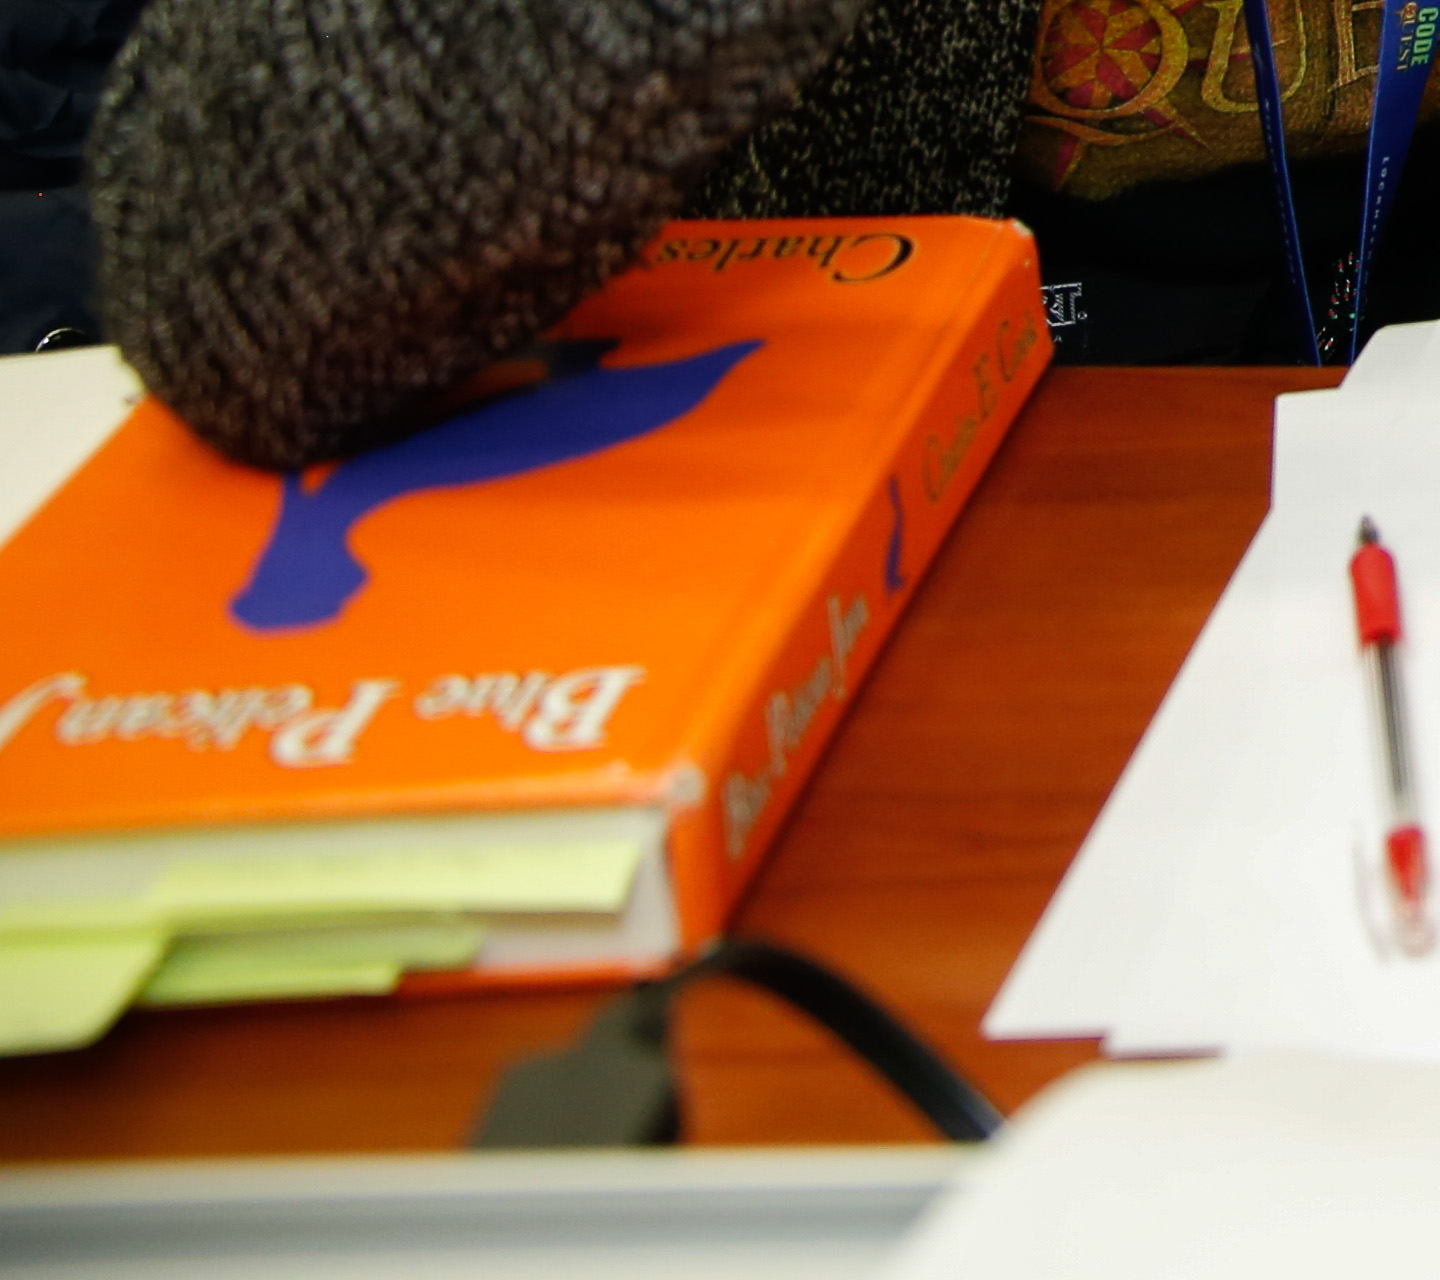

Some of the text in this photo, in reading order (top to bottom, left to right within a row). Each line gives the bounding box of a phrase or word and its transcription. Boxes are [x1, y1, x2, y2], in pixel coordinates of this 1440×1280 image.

[1410, 5, 1439, 67] CODE
[657, 233, 915, 286] Charles
[62, 680, 408, 772] Pelican
[414, 664, 648, 755] Blue
